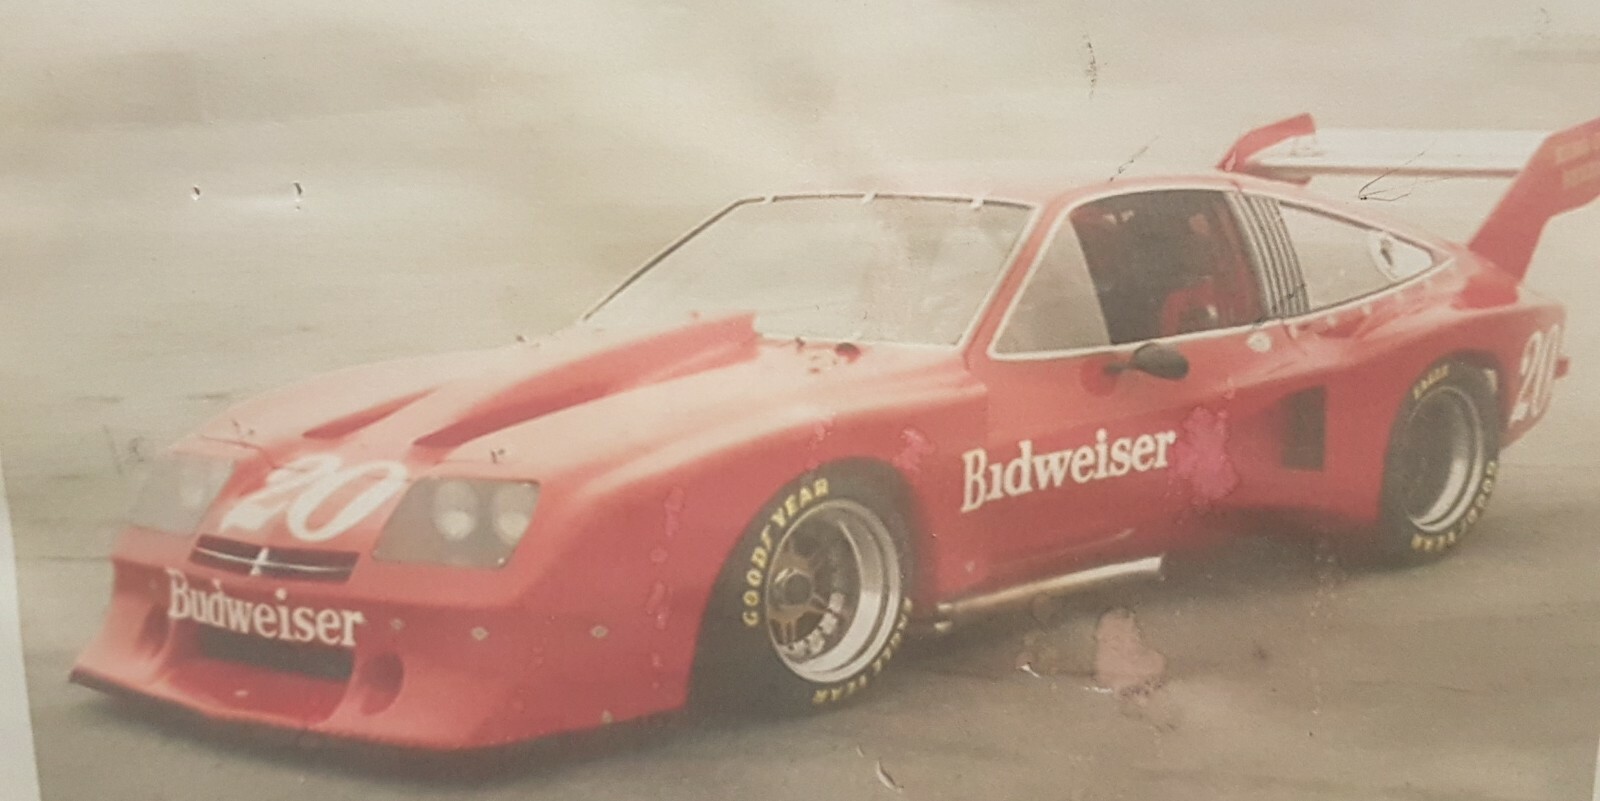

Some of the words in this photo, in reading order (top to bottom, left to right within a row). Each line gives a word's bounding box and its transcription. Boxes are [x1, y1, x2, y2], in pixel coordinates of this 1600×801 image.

[1509, 324, 1562, 428] 20
[219, 453, 408, 541] 20
[164, 567, 367, 646] Budweiser
